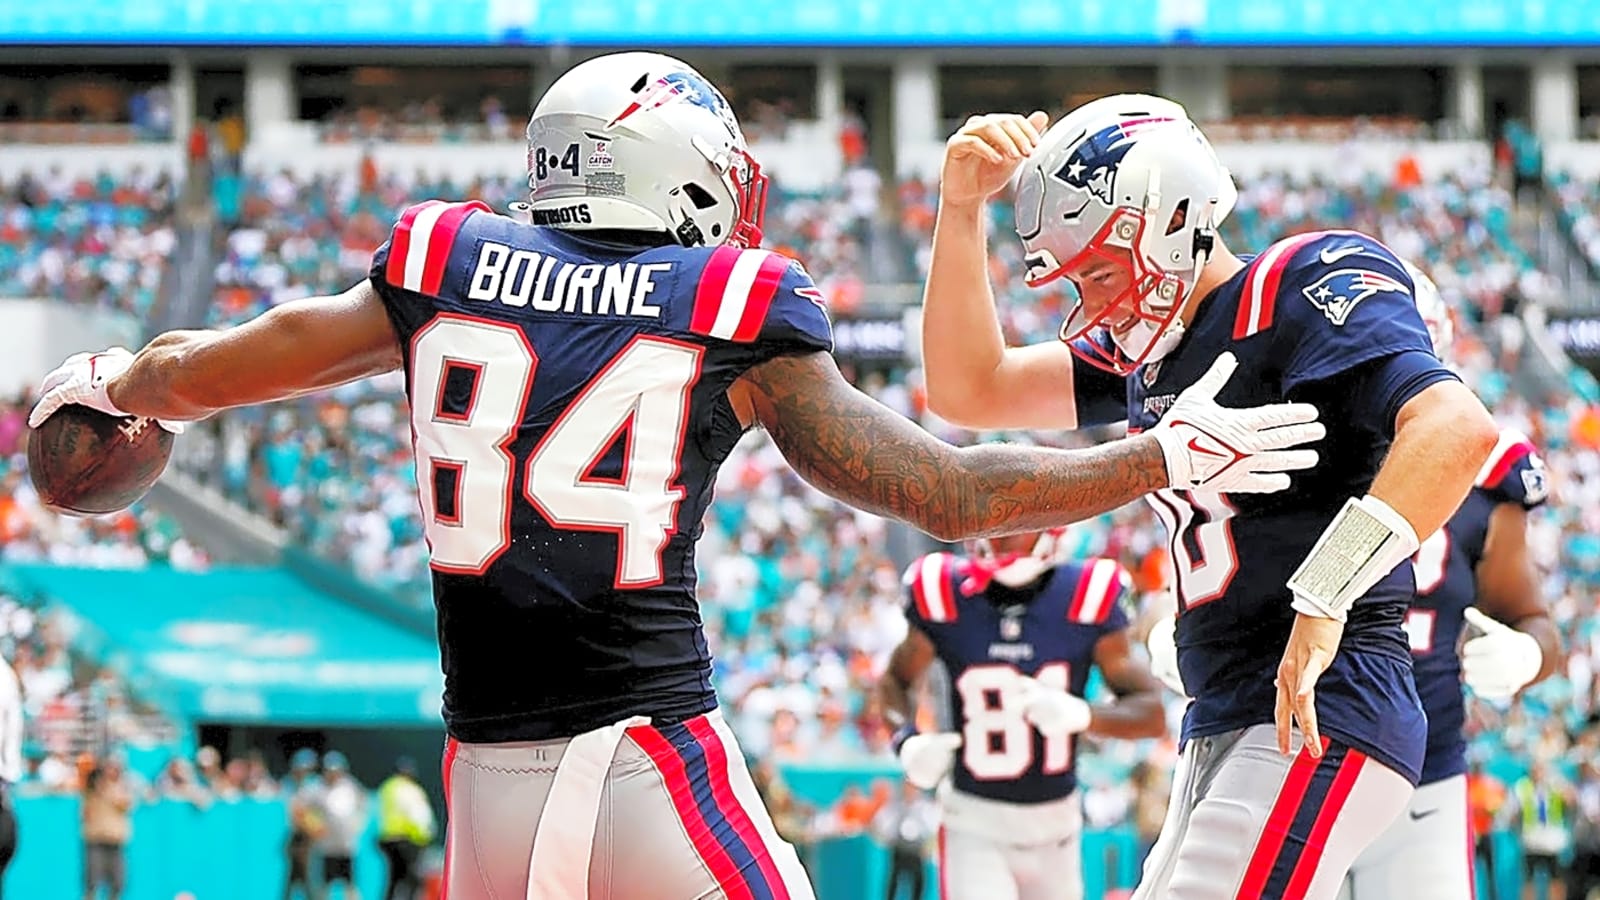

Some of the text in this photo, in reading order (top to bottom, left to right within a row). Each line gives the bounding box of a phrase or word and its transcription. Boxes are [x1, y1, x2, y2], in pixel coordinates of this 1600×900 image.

[532, 203, 592, 225] TRIOTS
[468, 242, 672, 317] BOURNE
[410, 311, 706, 590] 84
[956, 660, 1071, 781] 81
